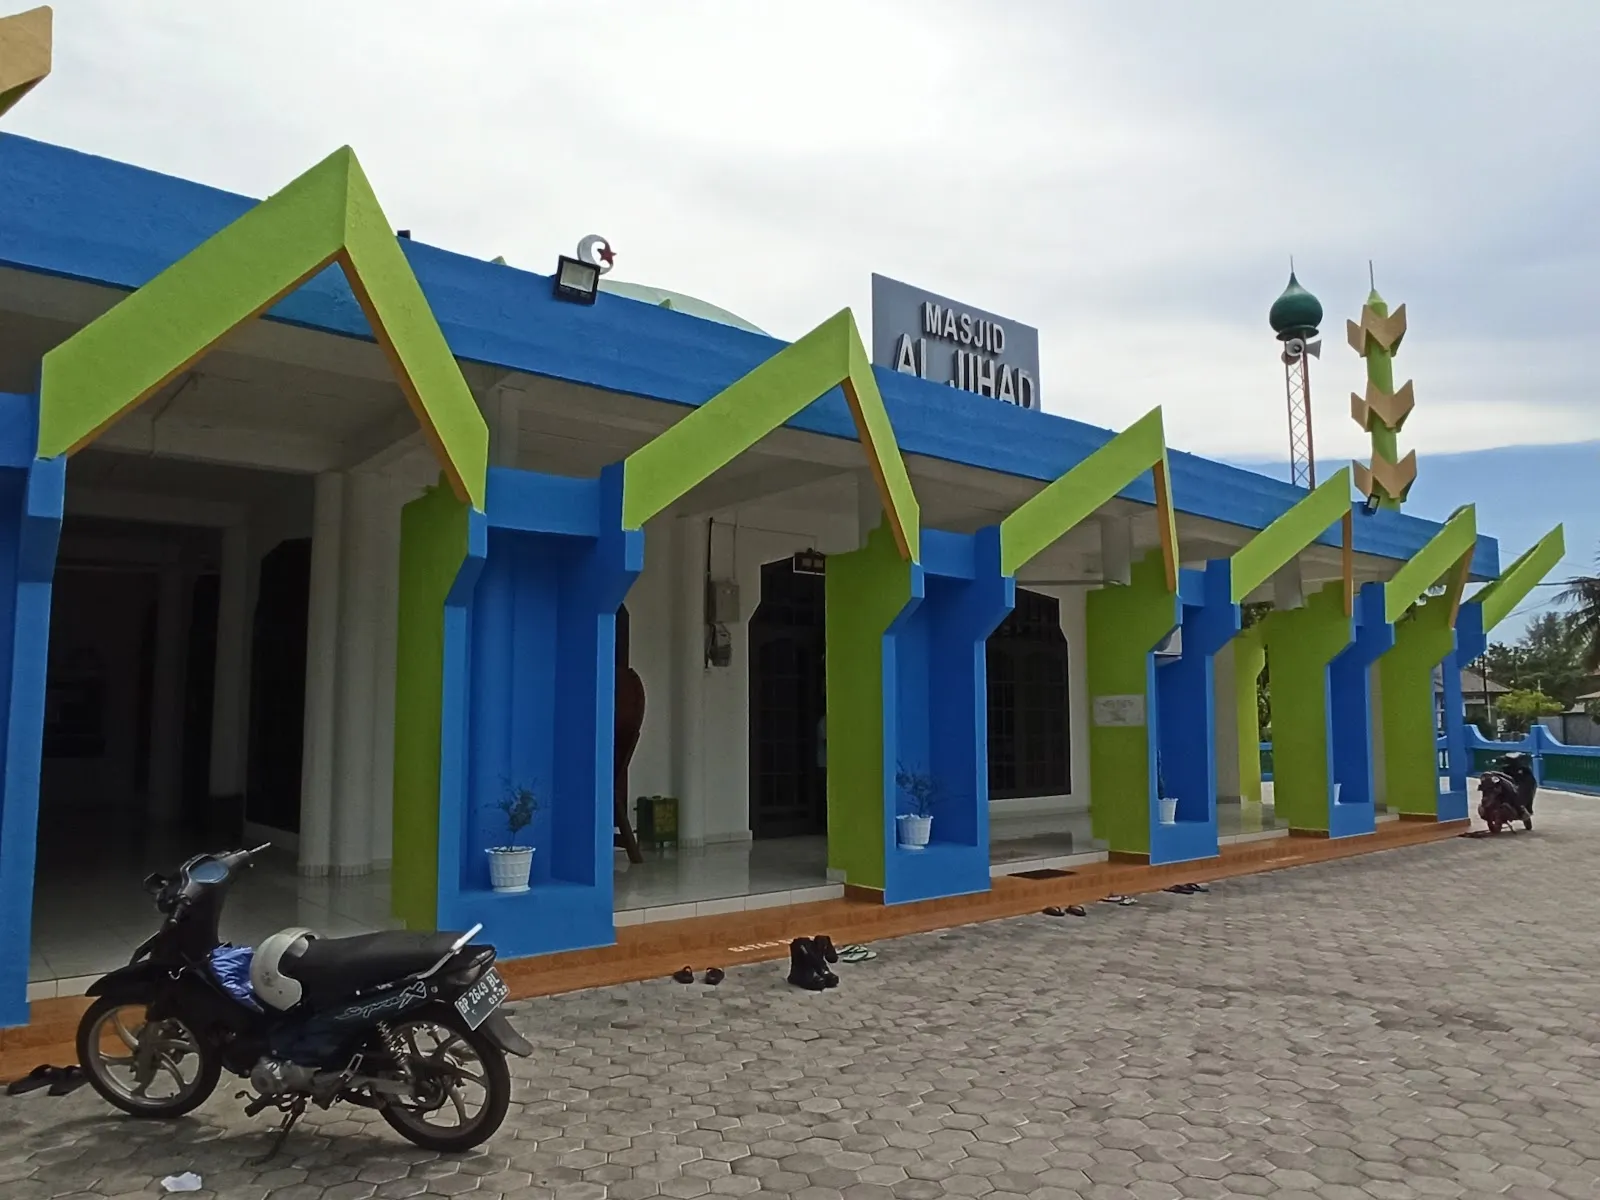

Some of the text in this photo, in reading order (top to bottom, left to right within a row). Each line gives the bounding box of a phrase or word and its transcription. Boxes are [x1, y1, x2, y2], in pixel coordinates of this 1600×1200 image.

[922, 301, 1006, 354] MASJID
[950, 349, 1035, 410] JIHAD
[469, 982, 489, 1004] 2649
[486, 973, 500, 988] BL
